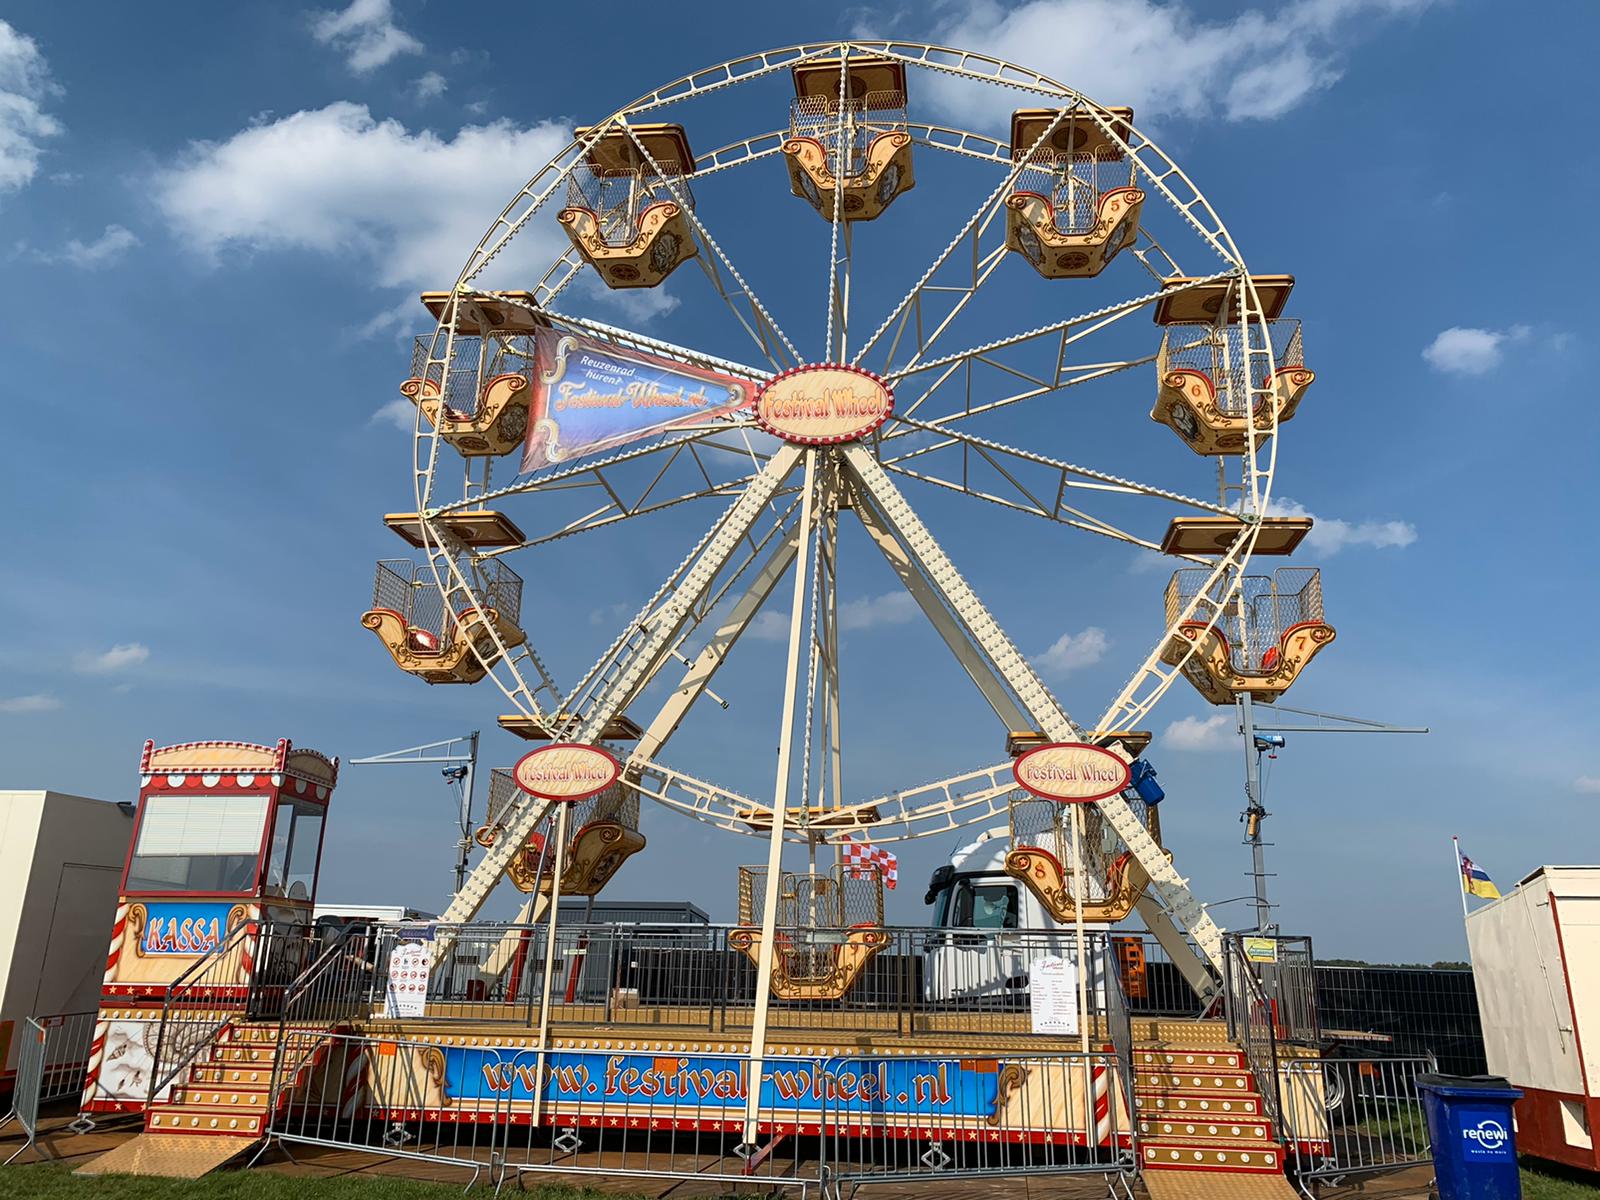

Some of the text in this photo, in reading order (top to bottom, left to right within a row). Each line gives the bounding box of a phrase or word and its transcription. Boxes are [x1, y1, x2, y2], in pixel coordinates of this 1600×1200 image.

[803, 149, 814, 161] 4
[1111, 200, 1120, 212] 5
[650, 214, 659, 225] 3
[580, 355, 635, 377] Reuzenrad
[585, 369, 622, 385] huren?
[1191, 384, 1201, 396] 6
[764, 387, 882, 418] Festival Wheel
[1295, 636, 1307, 650] 7
[524, 761, 608, 782] Festival Wheel
[1026, 761, 1119, 782] Festival Wheel
[1035, 861, 1046, 879] 8
[147, 917, 219, 952] KASSA
[1463, 1128, 1508, 1140] renewi
